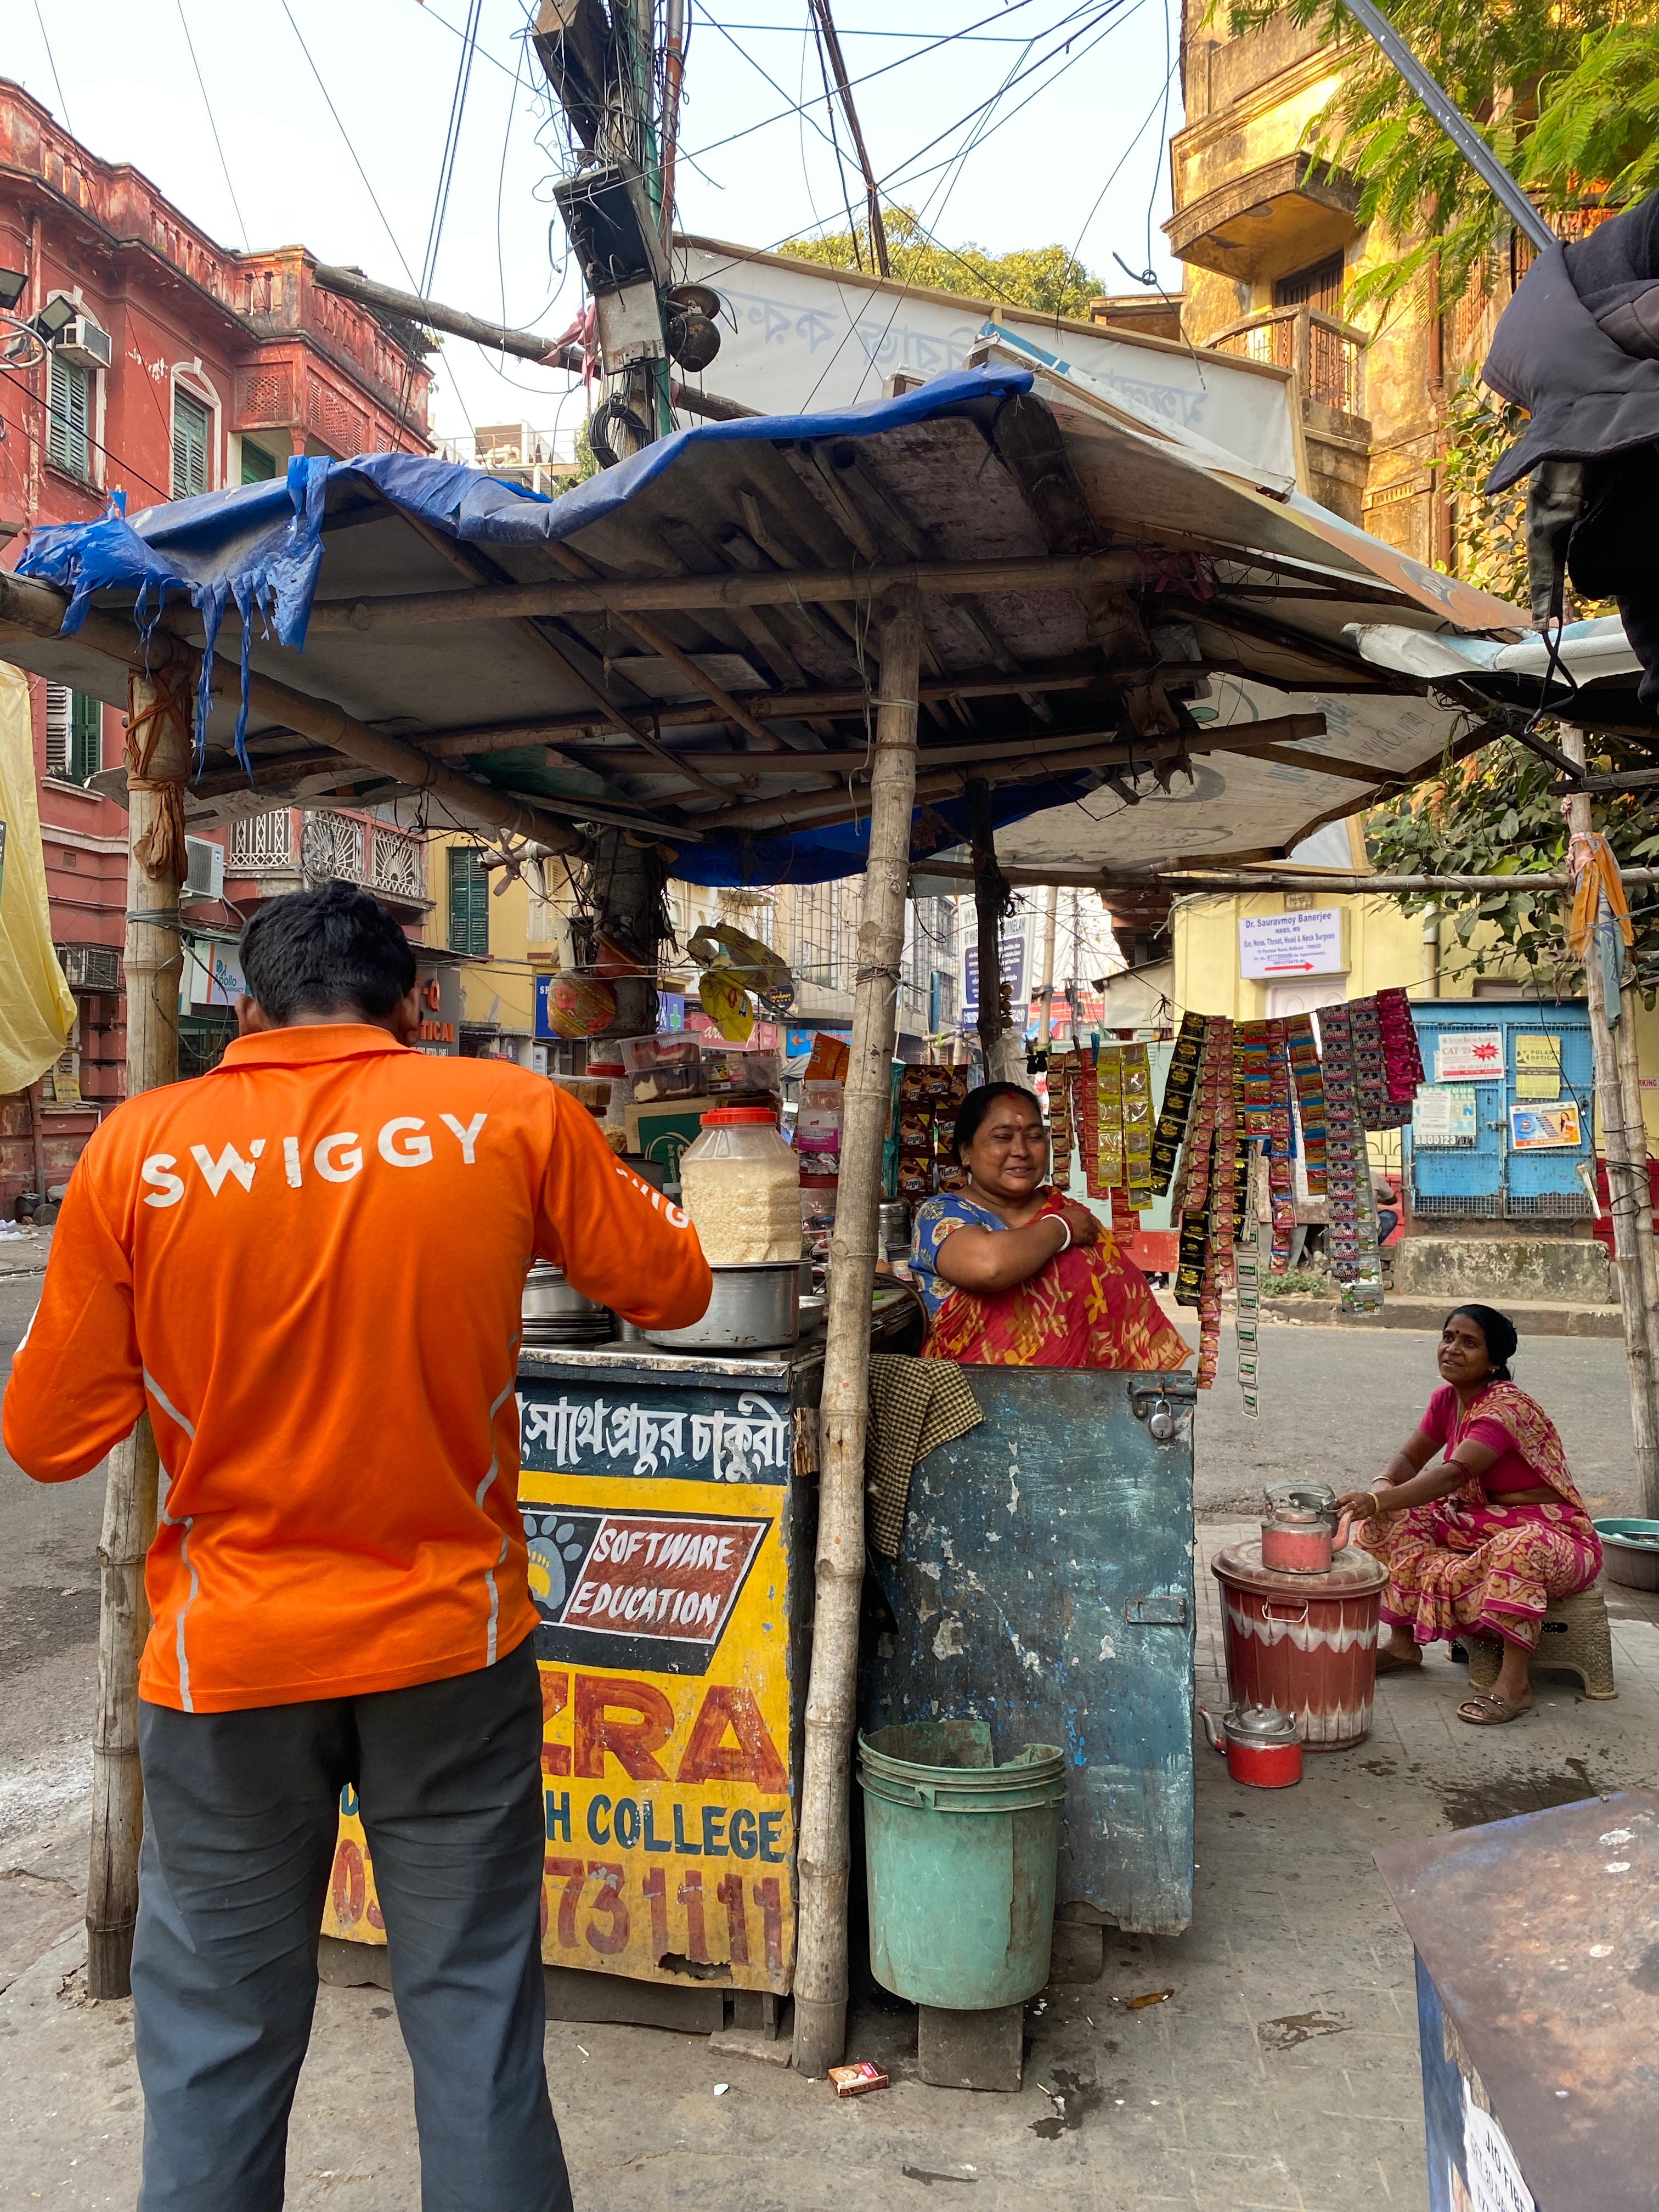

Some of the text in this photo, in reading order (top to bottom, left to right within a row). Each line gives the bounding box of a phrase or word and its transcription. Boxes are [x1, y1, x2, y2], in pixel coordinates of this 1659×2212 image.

[1246, 912, 1331, 928] Dr. Sauravmoy Banerjee
[1267, 937, 1283, 945] Throat,
[1315, 933, 1335, 941] Surgeon
[420, 1020, 456, 1042] TICAL
[141, 1113, 488, 1207] SWIGGY
[1415, 1136, 1475, 1145] 9800123
[606, 1403, 688, 1476] প্রচুর
[592, 1528, 736, 1571] SOFTWARE
[571, 1581, 721, 1626] EDUCATION
[587, 1795, 787, 1863] COLLEGE
